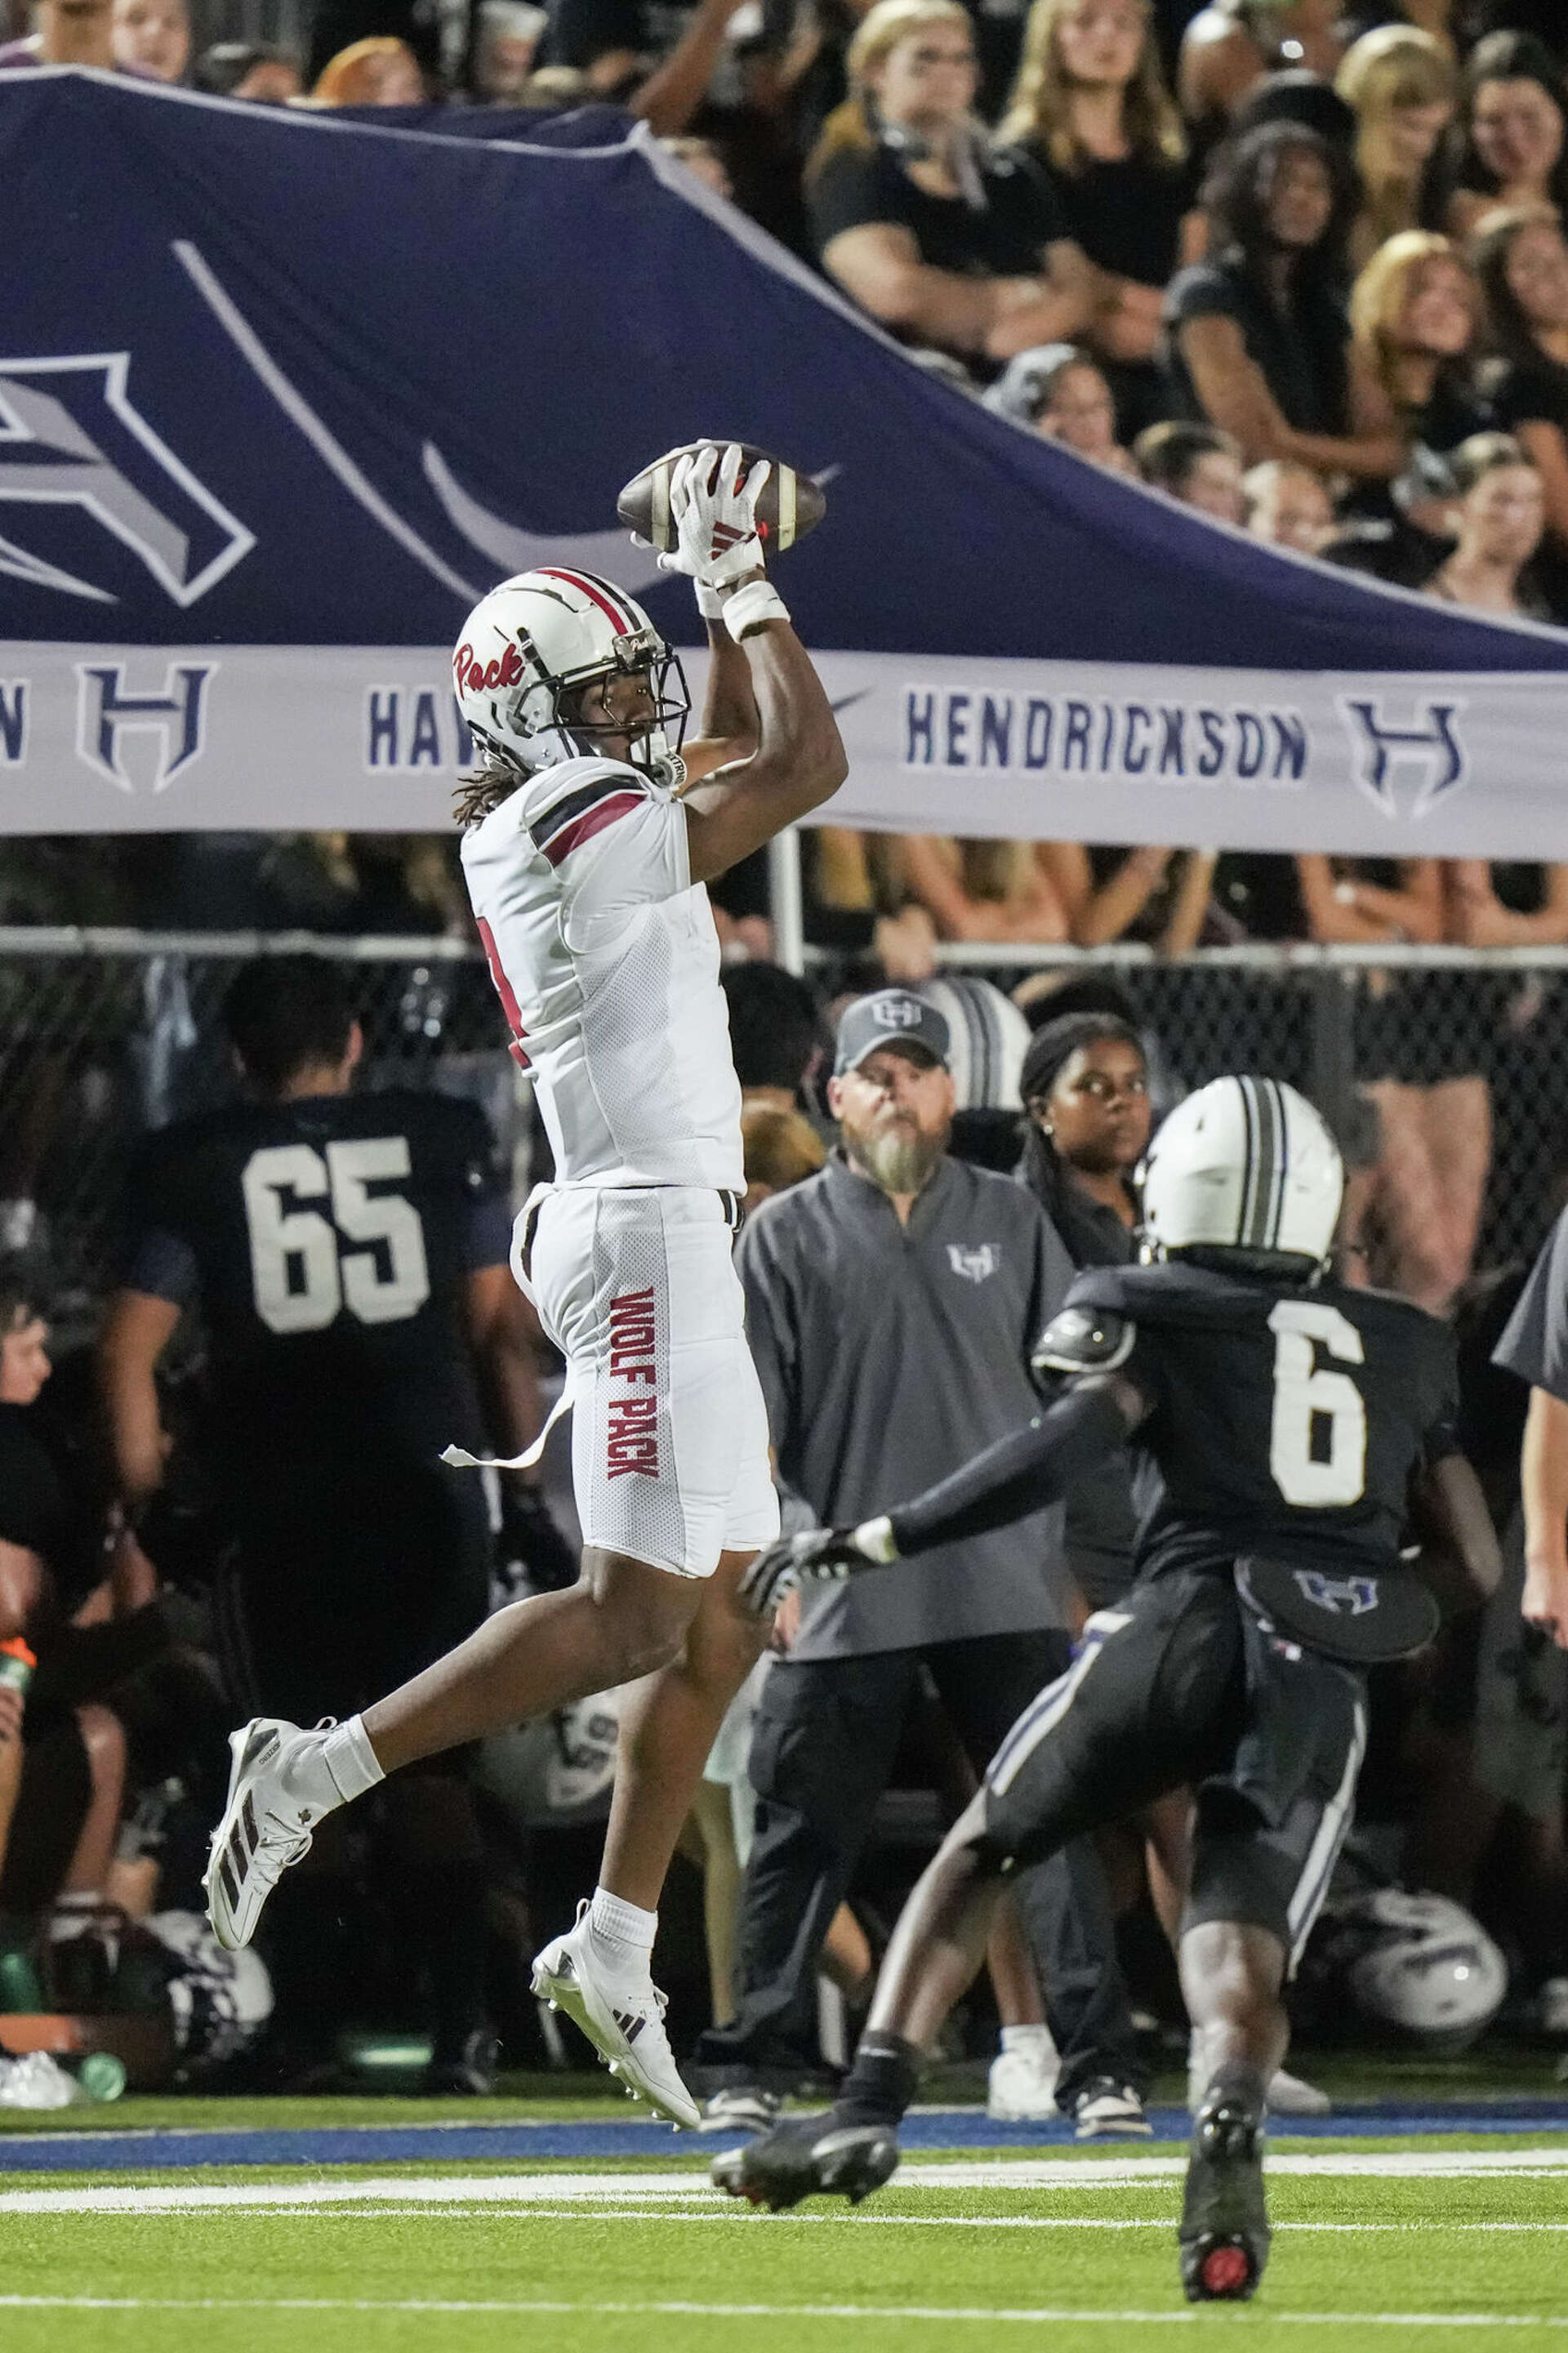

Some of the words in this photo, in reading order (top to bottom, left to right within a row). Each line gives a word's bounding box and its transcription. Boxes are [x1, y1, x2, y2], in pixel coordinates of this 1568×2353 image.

[452, 643, 526, 701] Pack
[904, 690, 1307, 780] HENDRICKSON
[241, 1134, 431, 1335] 65
[609, 1286, 656, 1387] WOLF
[607, 1397, 660, 1481] PACK
[1267, 1299, 1368, 1509] 6
